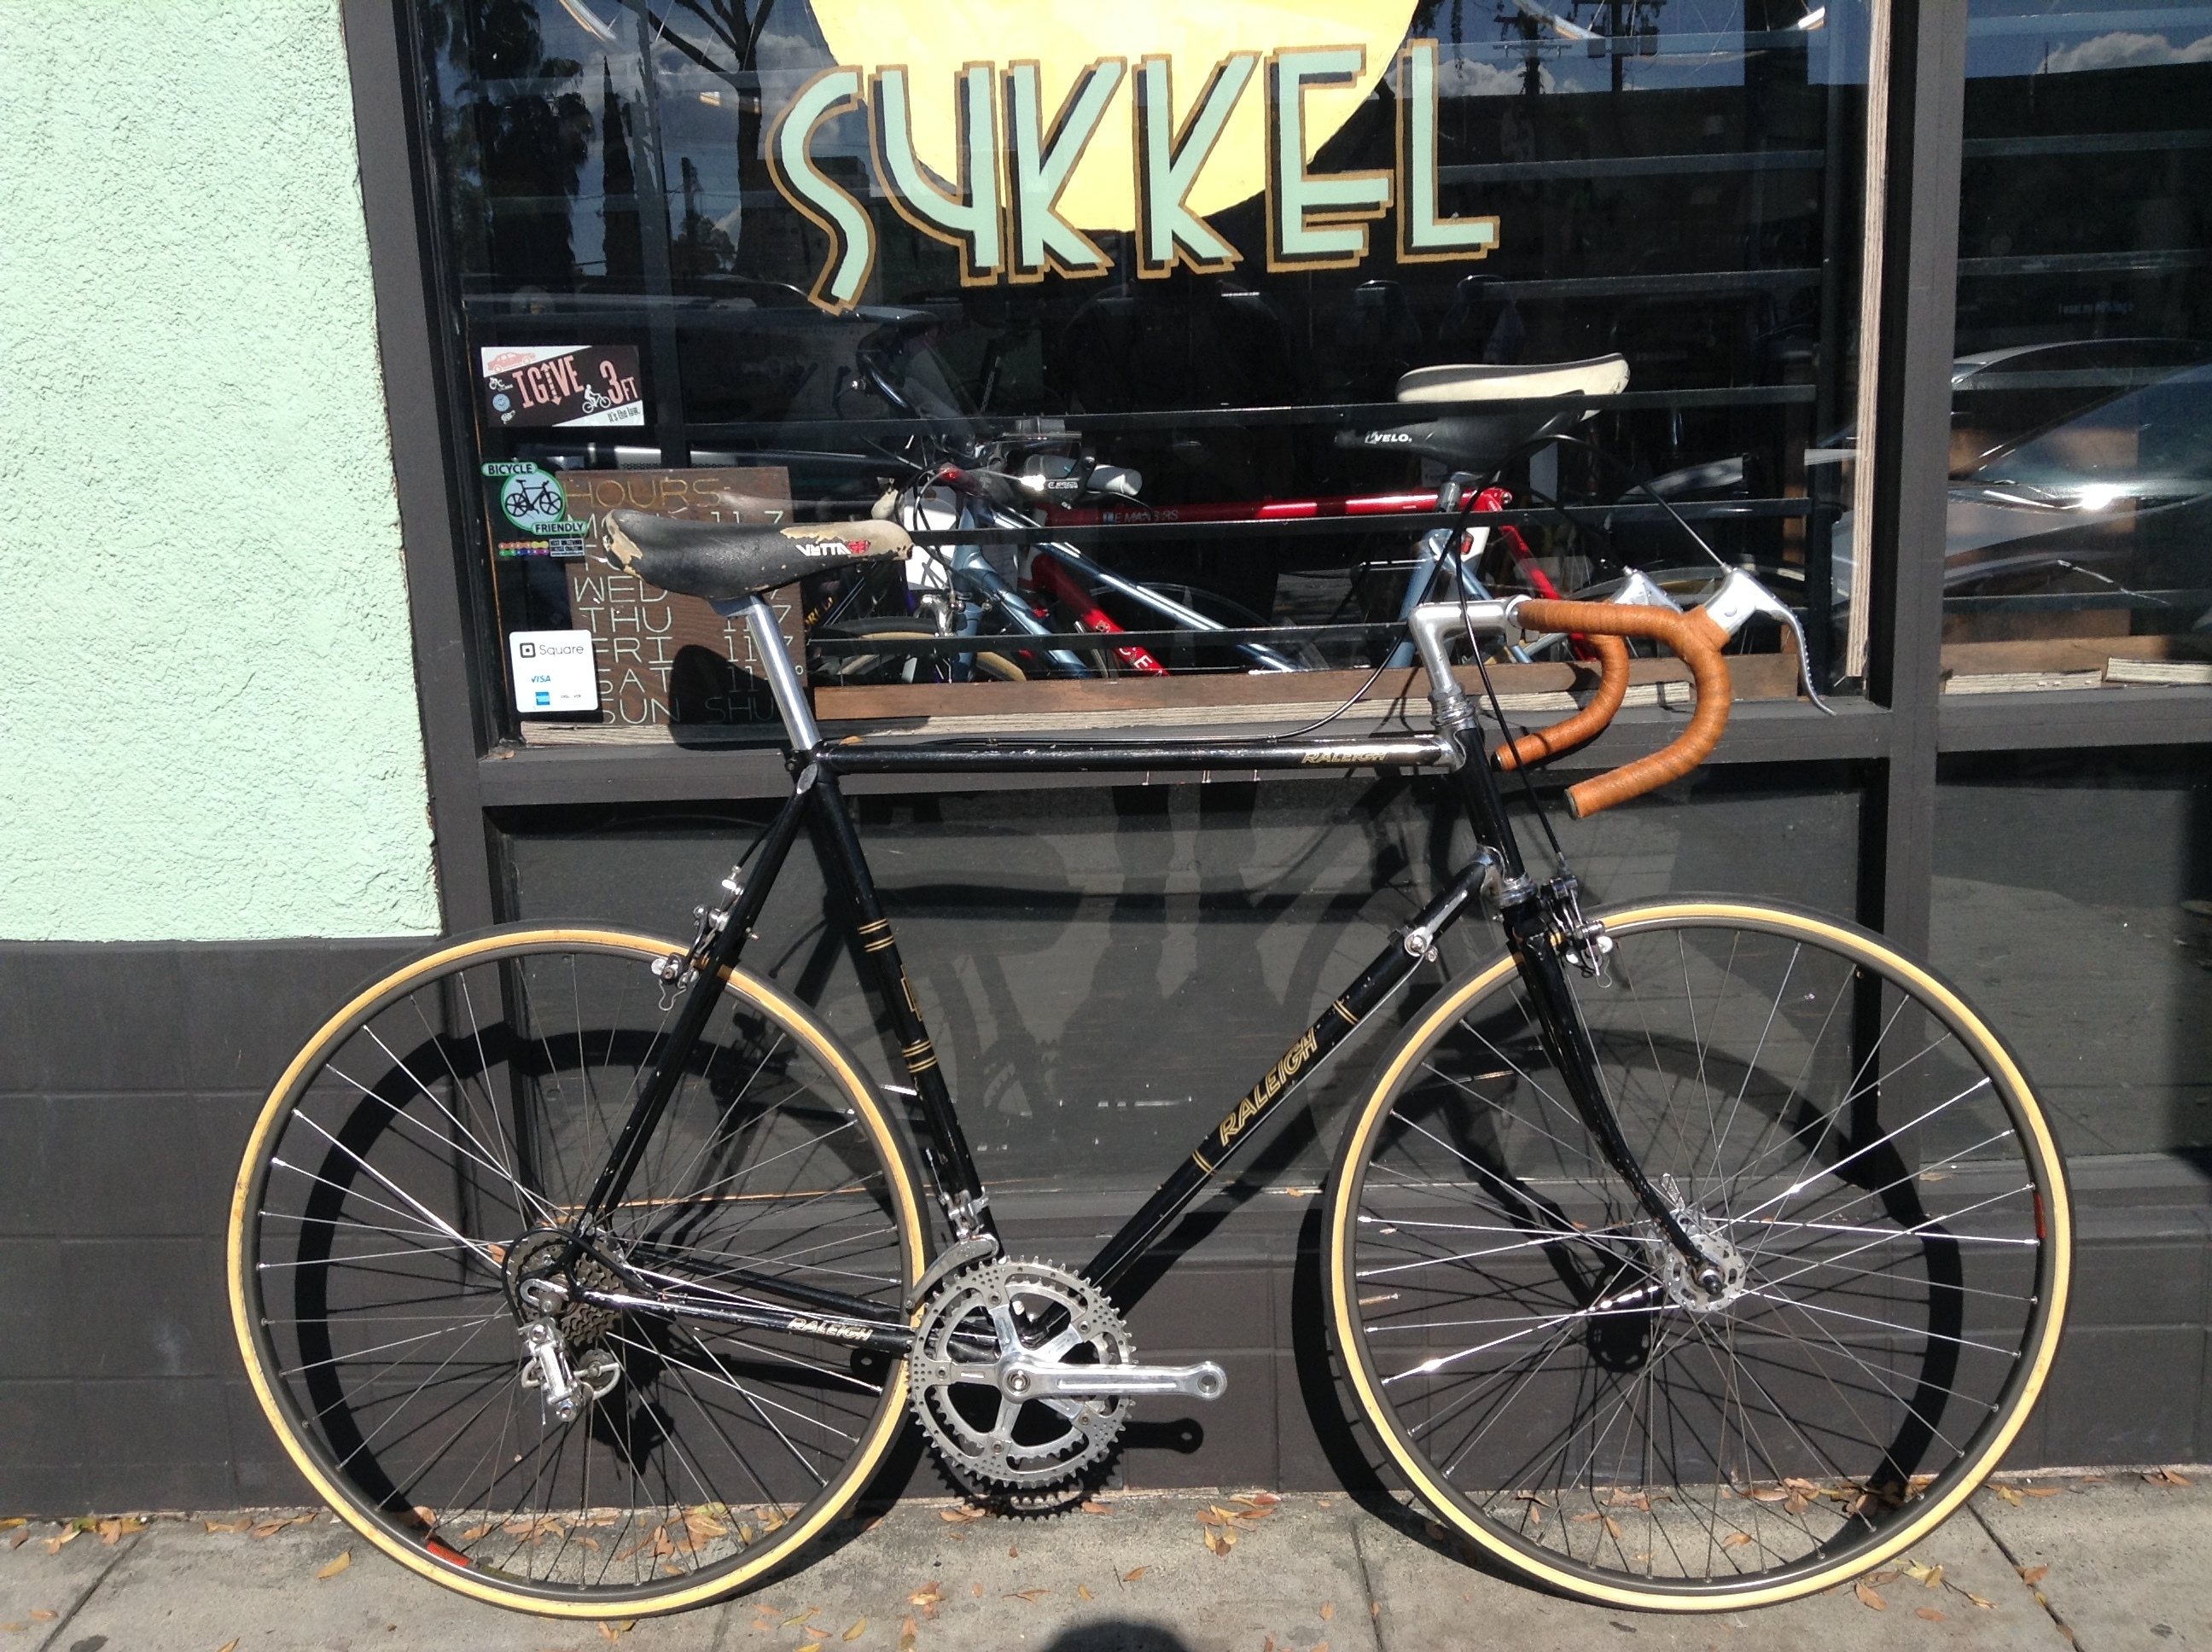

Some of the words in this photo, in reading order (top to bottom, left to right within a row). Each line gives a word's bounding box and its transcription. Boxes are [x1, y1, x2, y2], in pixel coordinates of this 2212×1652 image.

[765, 38, 1500, 316] SYKKEL
[512, 370, 534, 409] I
[527, 355, 585, 405] GIVE
[487, 463, 533, 475] BICYCLE
[563, 479, 724, 509] HOURS
[535, 522, 584, 534] FRIENDLY
[579, 606, 672, 633] THU
[538, 644, 584, 657] Square
[705, 696, 775, 724] SHU
[1301, 751, 1388, 764] RALEIGH
[1220, 1027, 1318, 1147] RALEIGH
[787, 1317, 874, 1341] RALEIGH
